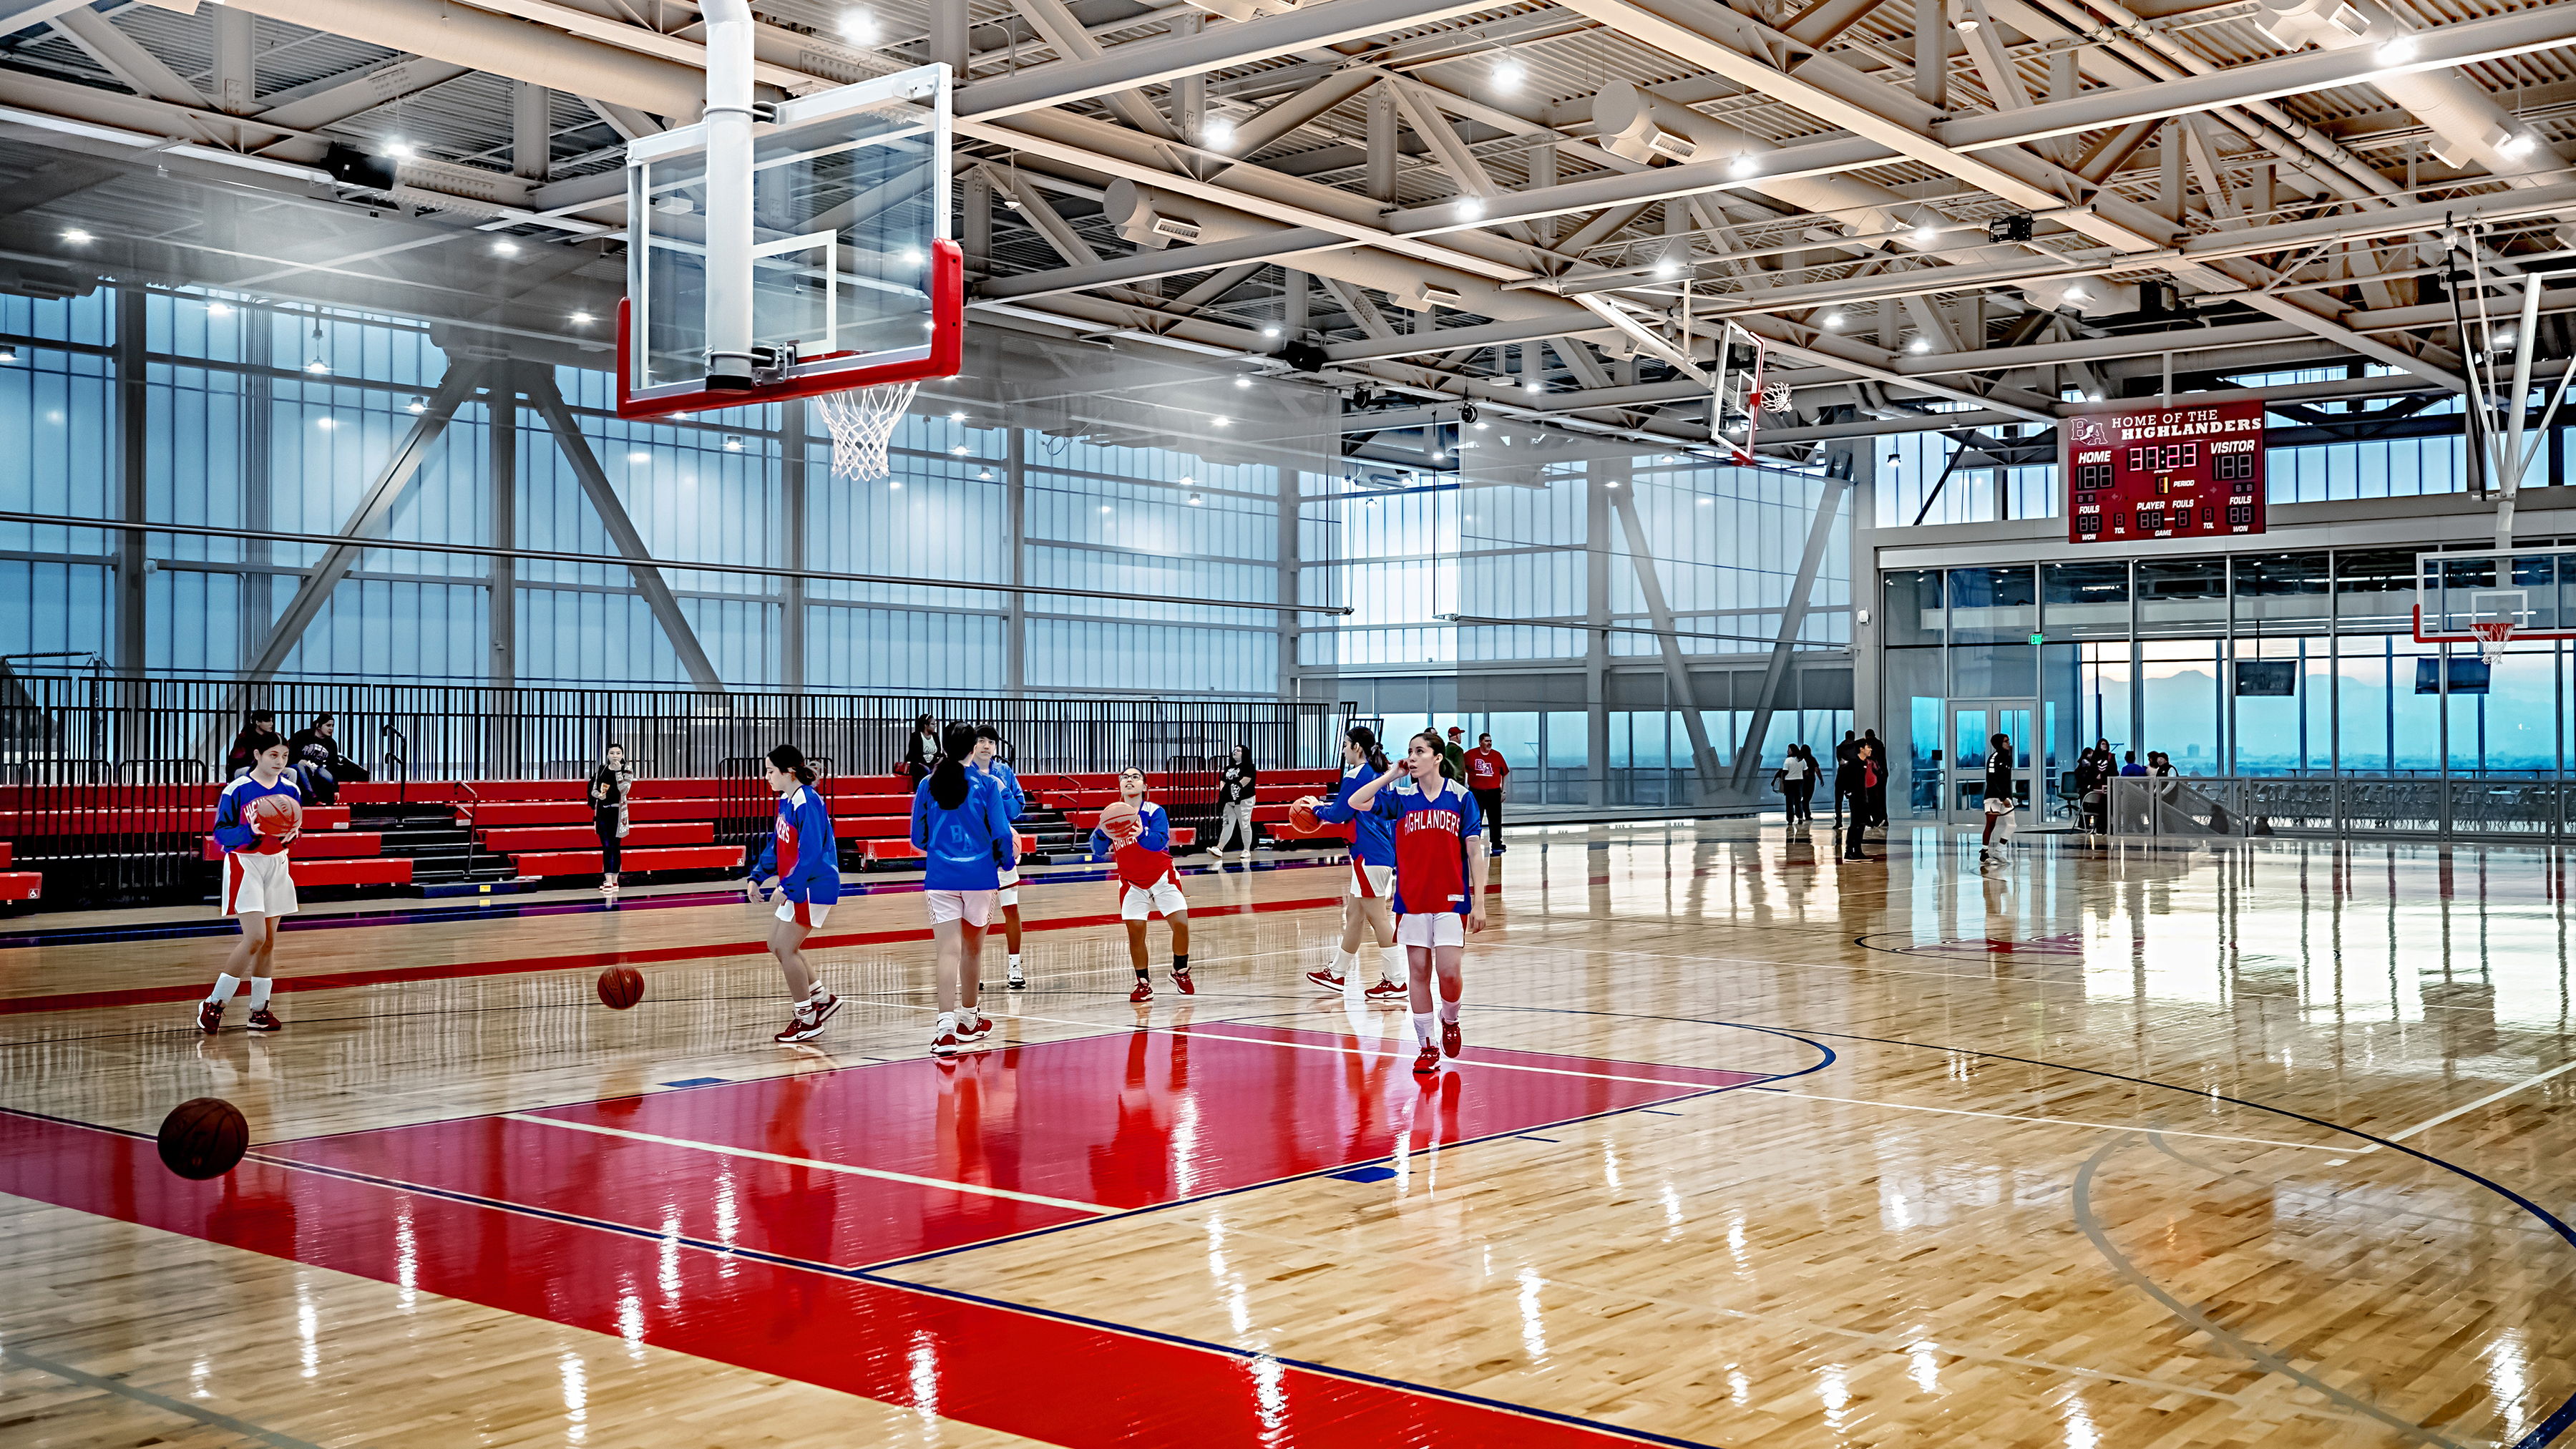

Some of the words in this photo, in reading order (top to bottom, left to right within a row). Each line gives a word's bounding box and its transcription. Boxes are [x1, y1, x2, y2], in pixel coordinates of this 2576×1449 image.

[2112, 414, 2157, 429] HOME
[2162, 412, 2183, 424] OF
[2187, 409, 2218, 422] THE
[2121, 417, 2262, 440] HIGHLANDERS
[2210, 439, 2255, 454] VISITOR
[2078, 450, 2112, 464] HOME
[2129, 443, 2197, 472] 37:23
[2173, 479, 2195, 488] PERIOD
[2136, 501, 2166, 511] PLAYER
[2172, 499, 2195, 509] FOULS
[2229, 495, 2252, 505] FOULS
[2079, 504, 2100, 514] FOULS
